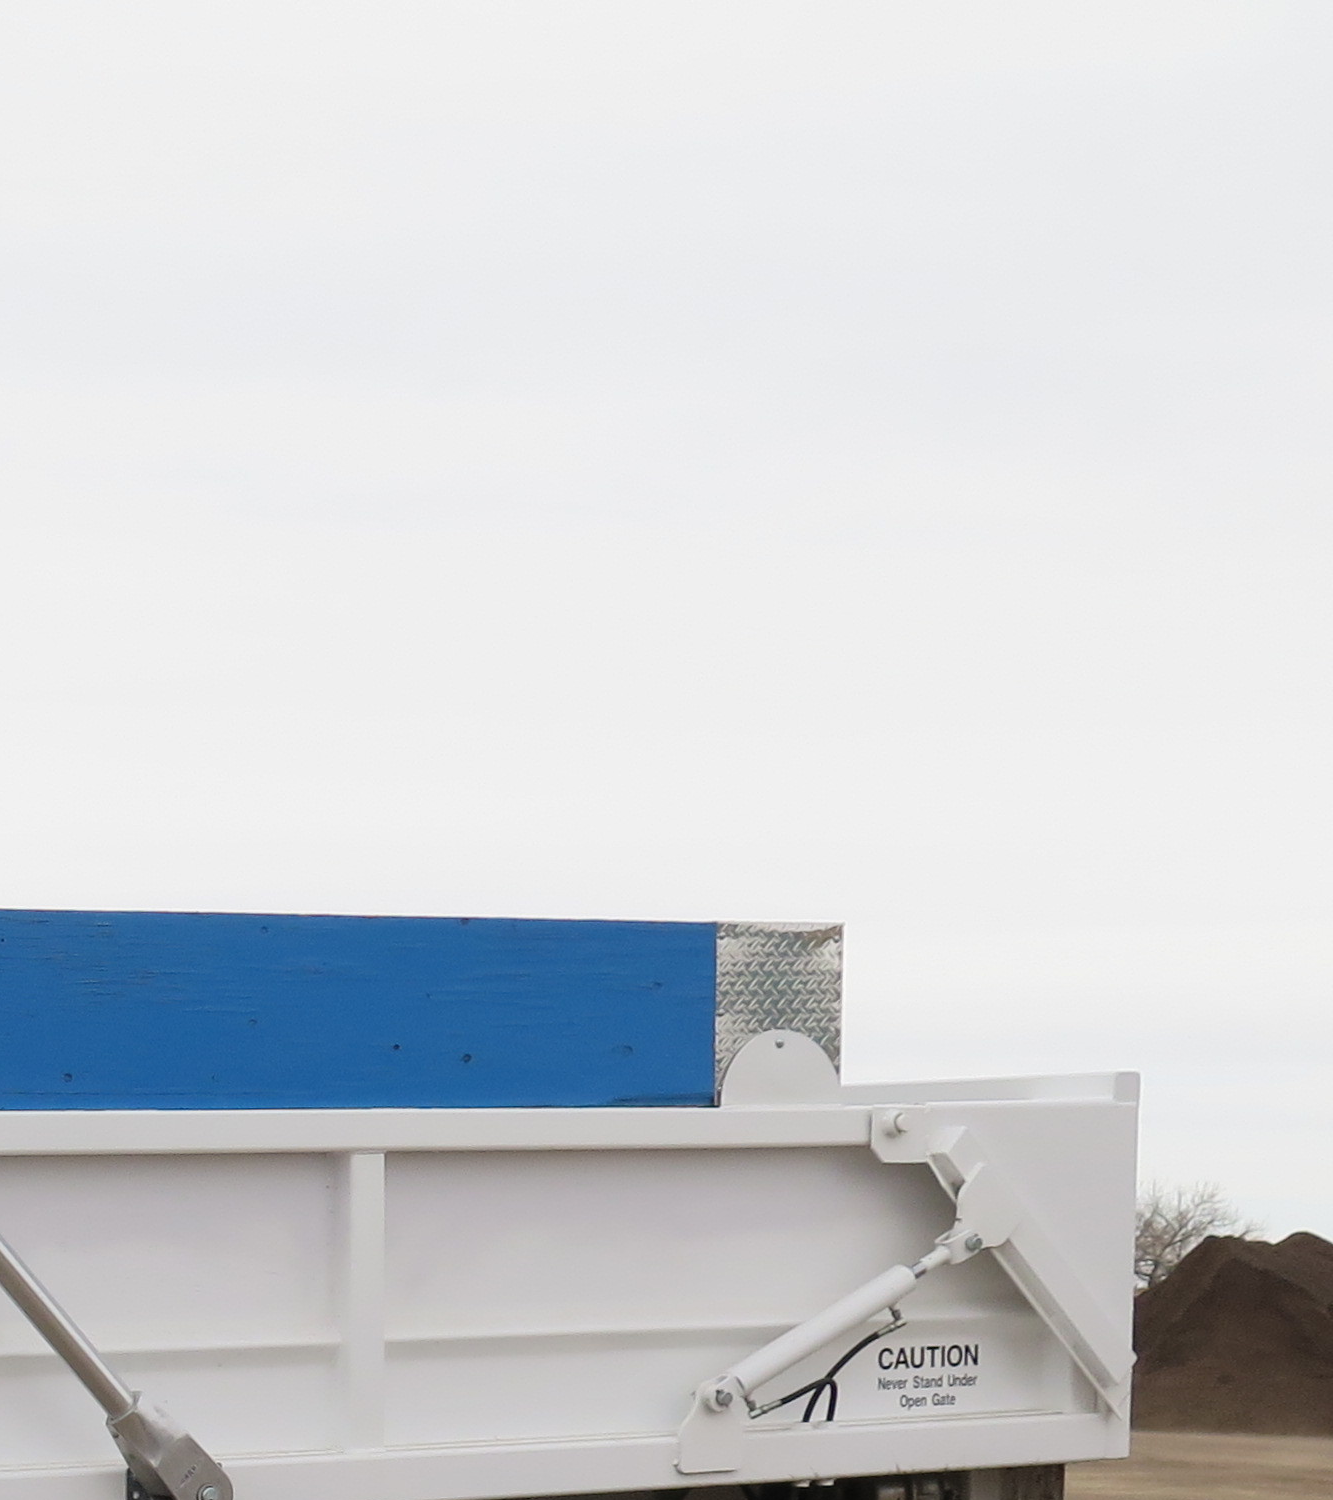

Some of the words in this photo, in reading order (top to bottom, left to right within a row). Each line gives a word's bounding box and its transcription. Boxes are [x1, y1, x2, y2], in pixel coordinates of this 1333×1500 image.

[878, 1344, 979, 1370] CAUTION
[878, 1377, 908, 1391] Never
[913, 1375, 943, 1389] Stand
[947, 1373, 978, 1387] Under
[899, 1394, 927, 1410] Open
[931, 1393, 956, 1406] Gate
